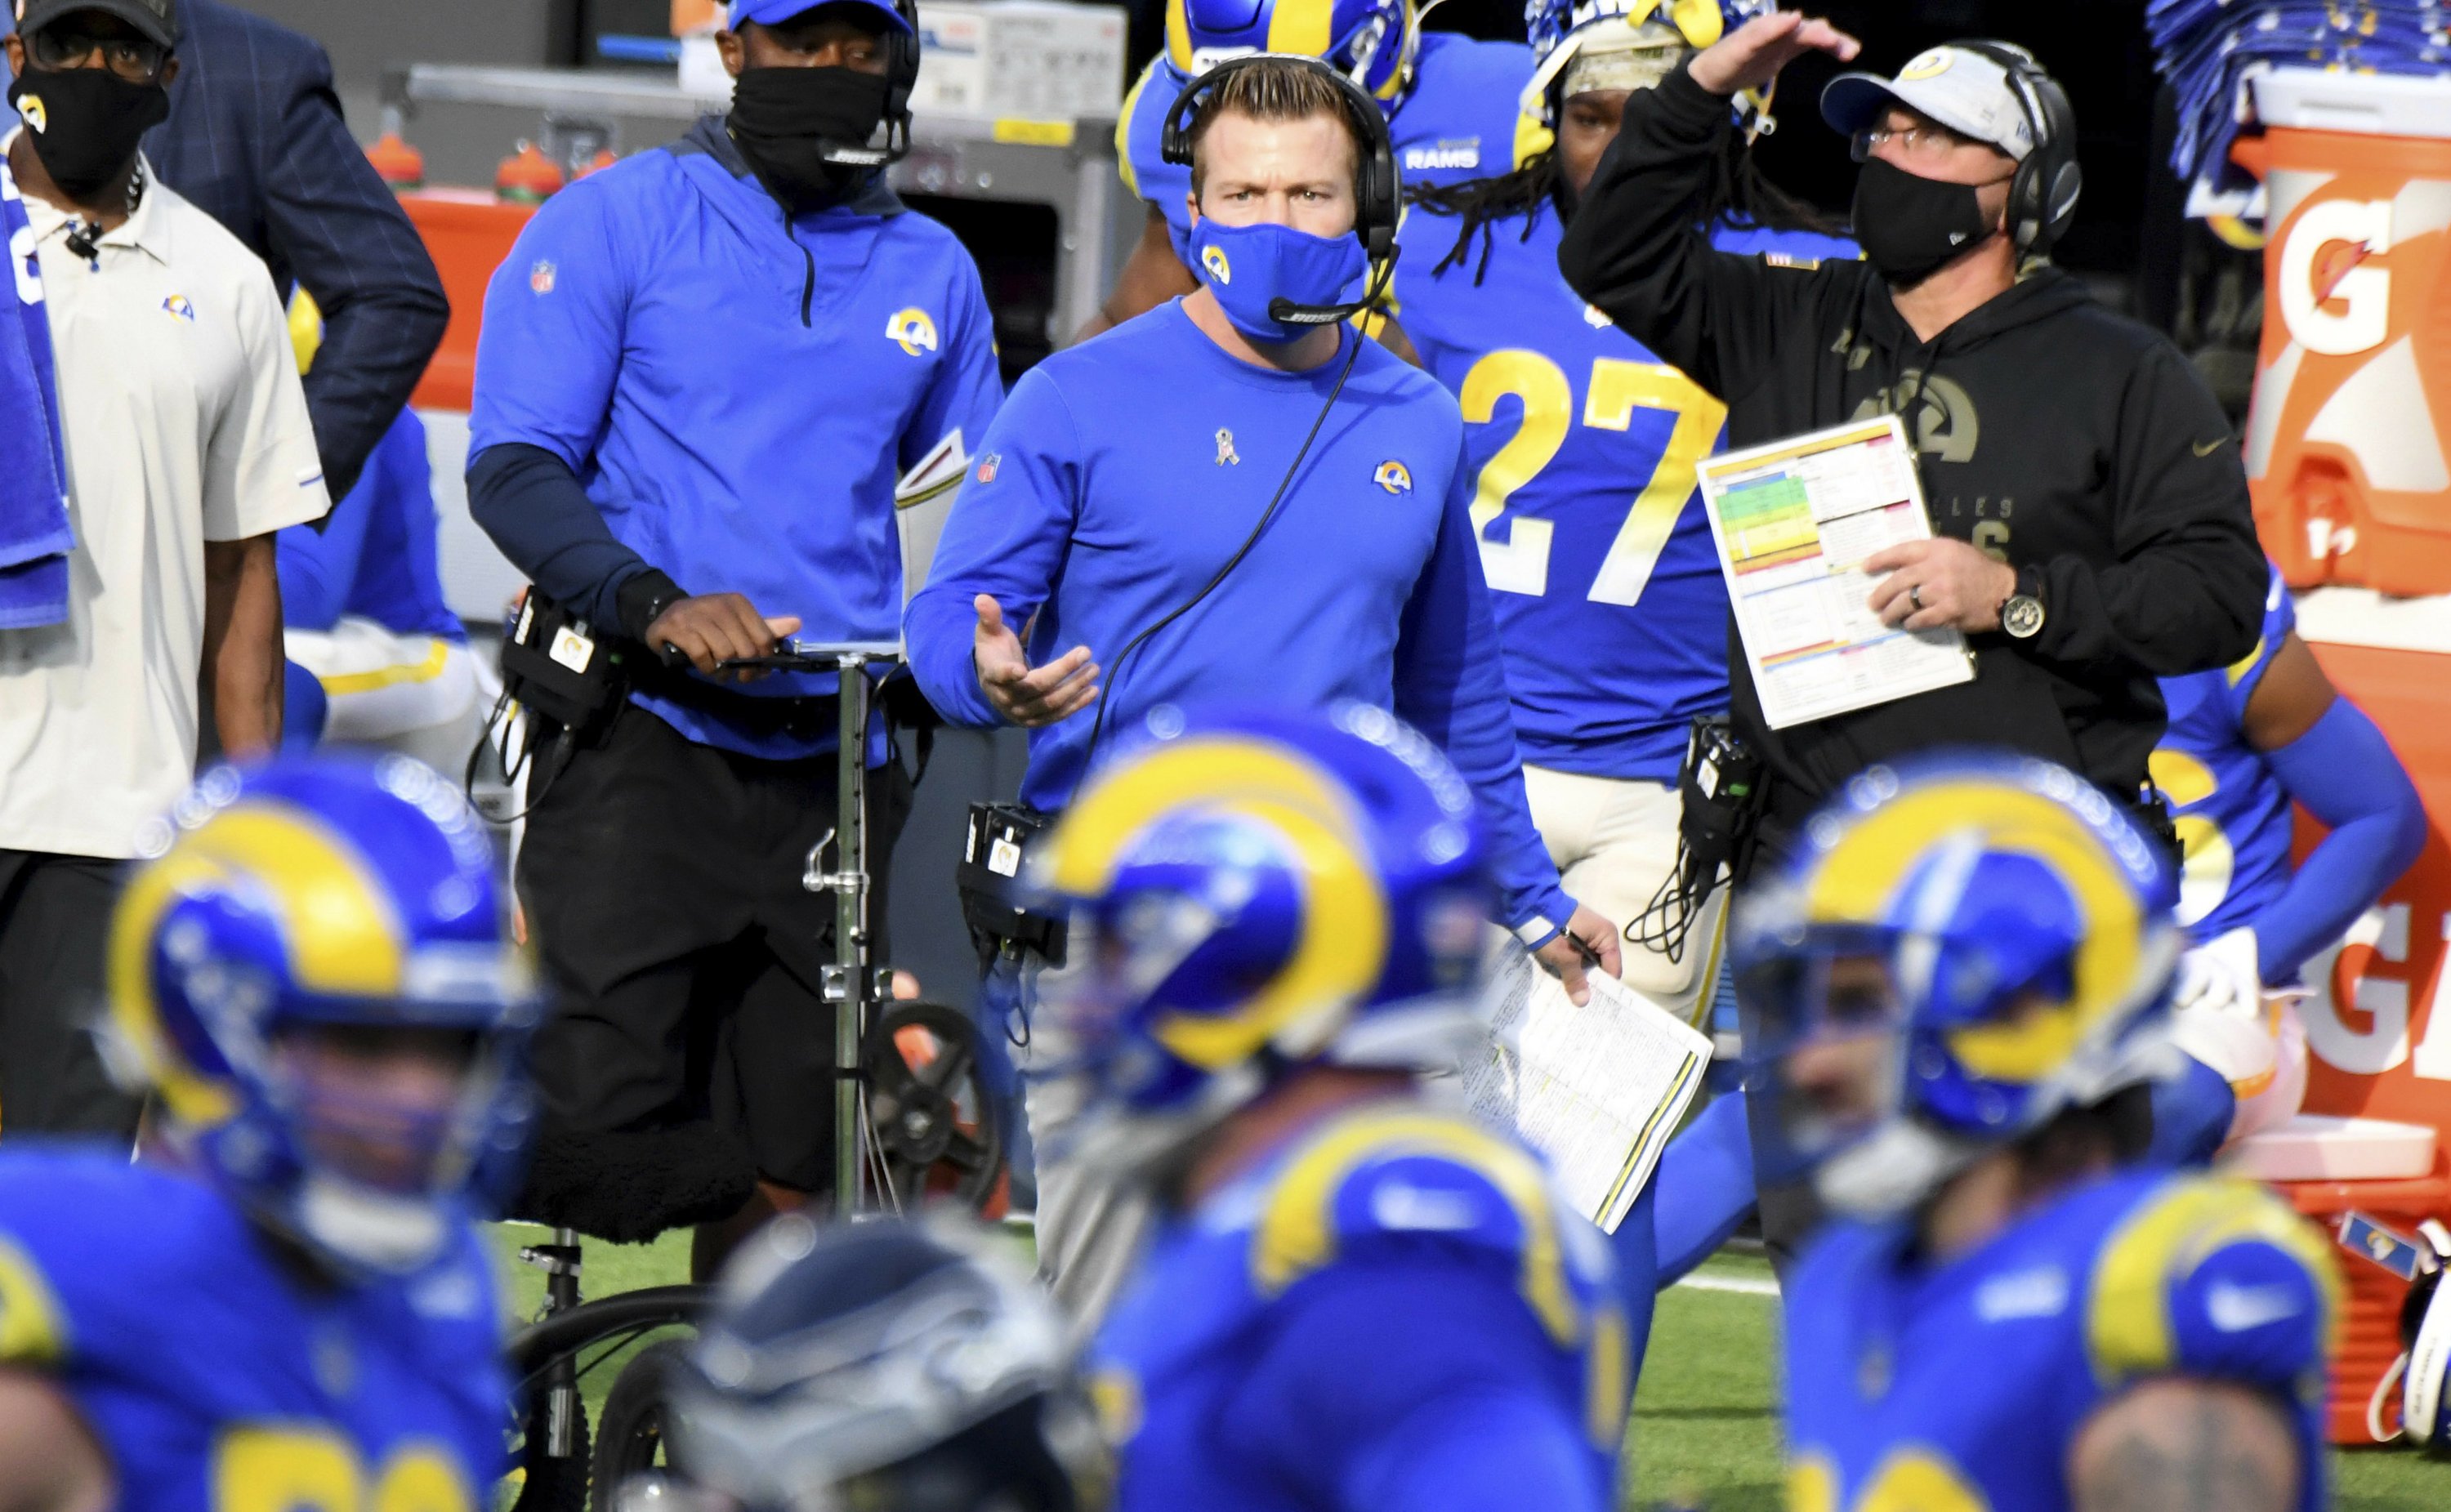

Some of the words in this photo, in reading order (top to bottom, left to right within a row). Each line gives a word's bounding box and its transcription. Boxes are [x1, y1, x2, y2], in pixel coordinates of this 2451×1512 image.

[1405, 149, 1479, 169] RAMS
[1279, 312, 1346, 323] BOSE
[2279, 200, 2392, 355] G
[1460, 349, 1729, 607] 27
